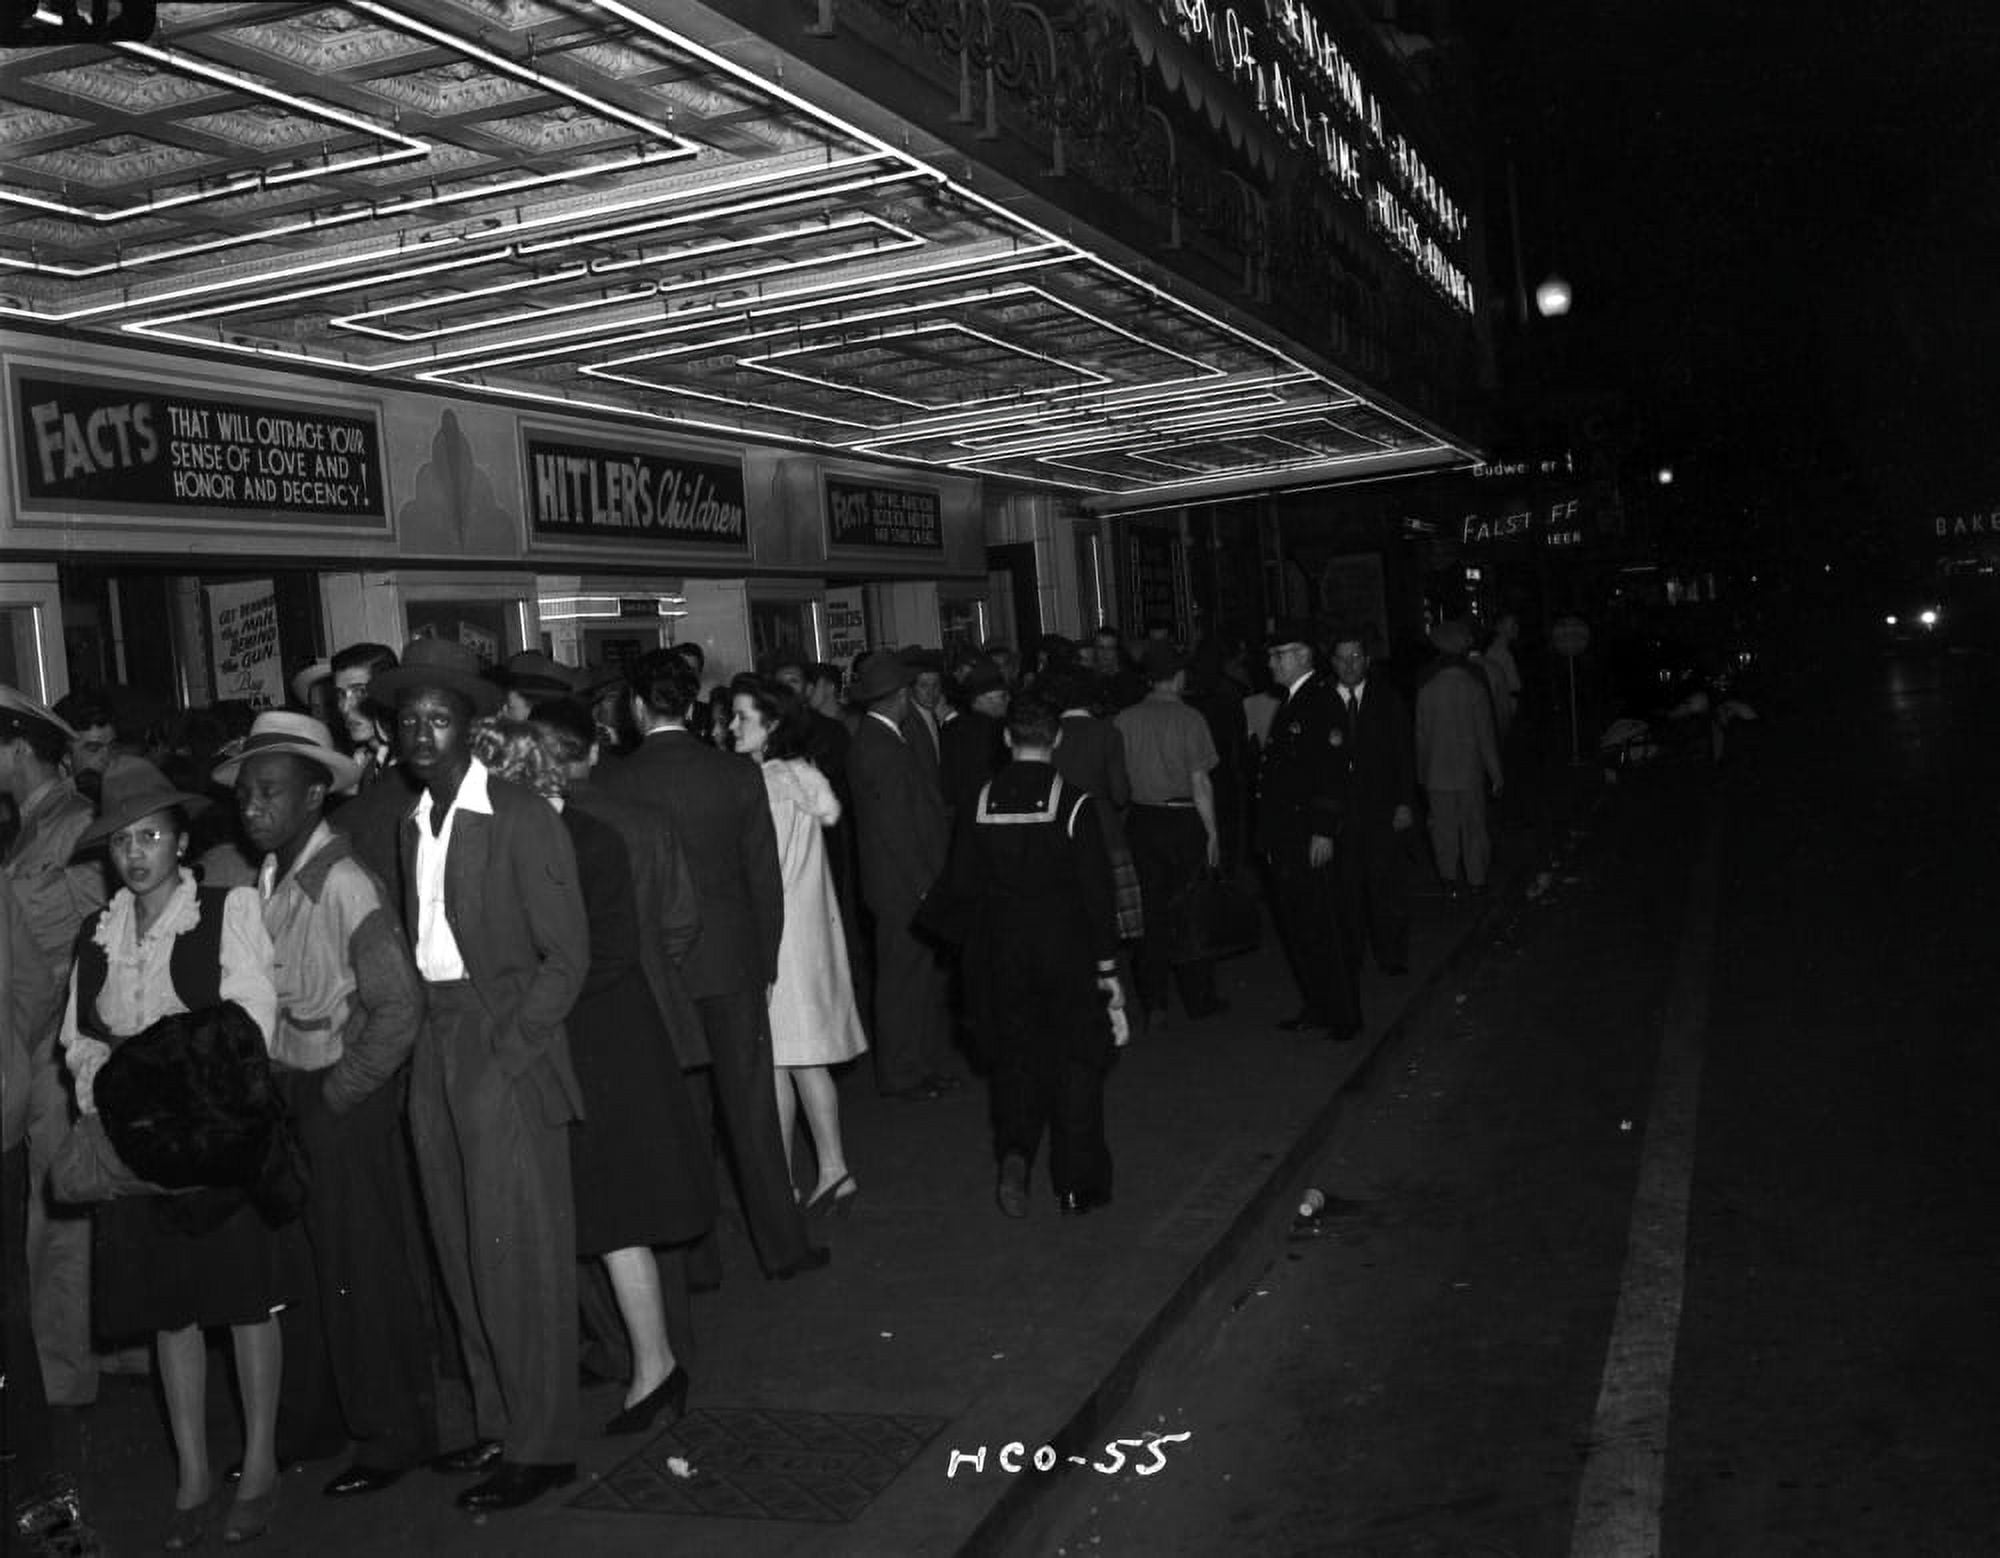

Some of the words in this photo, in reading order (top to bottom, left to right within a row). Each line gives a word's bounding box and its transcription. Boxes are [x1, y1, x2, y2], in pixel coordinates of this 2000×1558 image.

[32, 400, 158, 484] FACTS
[168, 407, 208, 439] THAT
[217, 411, 254, 443] WILL
[256, 417, 324, 450] OUTRAGE
[327, 424, 365, 454] YOUR
[170, 441, 222, 471] SENSE
[227, 445, 250, 472] OF
[258, 448, 306, 476] LOVE
[315, 455, 349, 479] AND
[174, 471, 236, 499] HONOR
[244, 477, 277, 500] AND
[535, 453, 654, 528] HITLER'S
[657, 467, 742, 536] Children
[1463, 499, 1579, 544] FALSTFF
